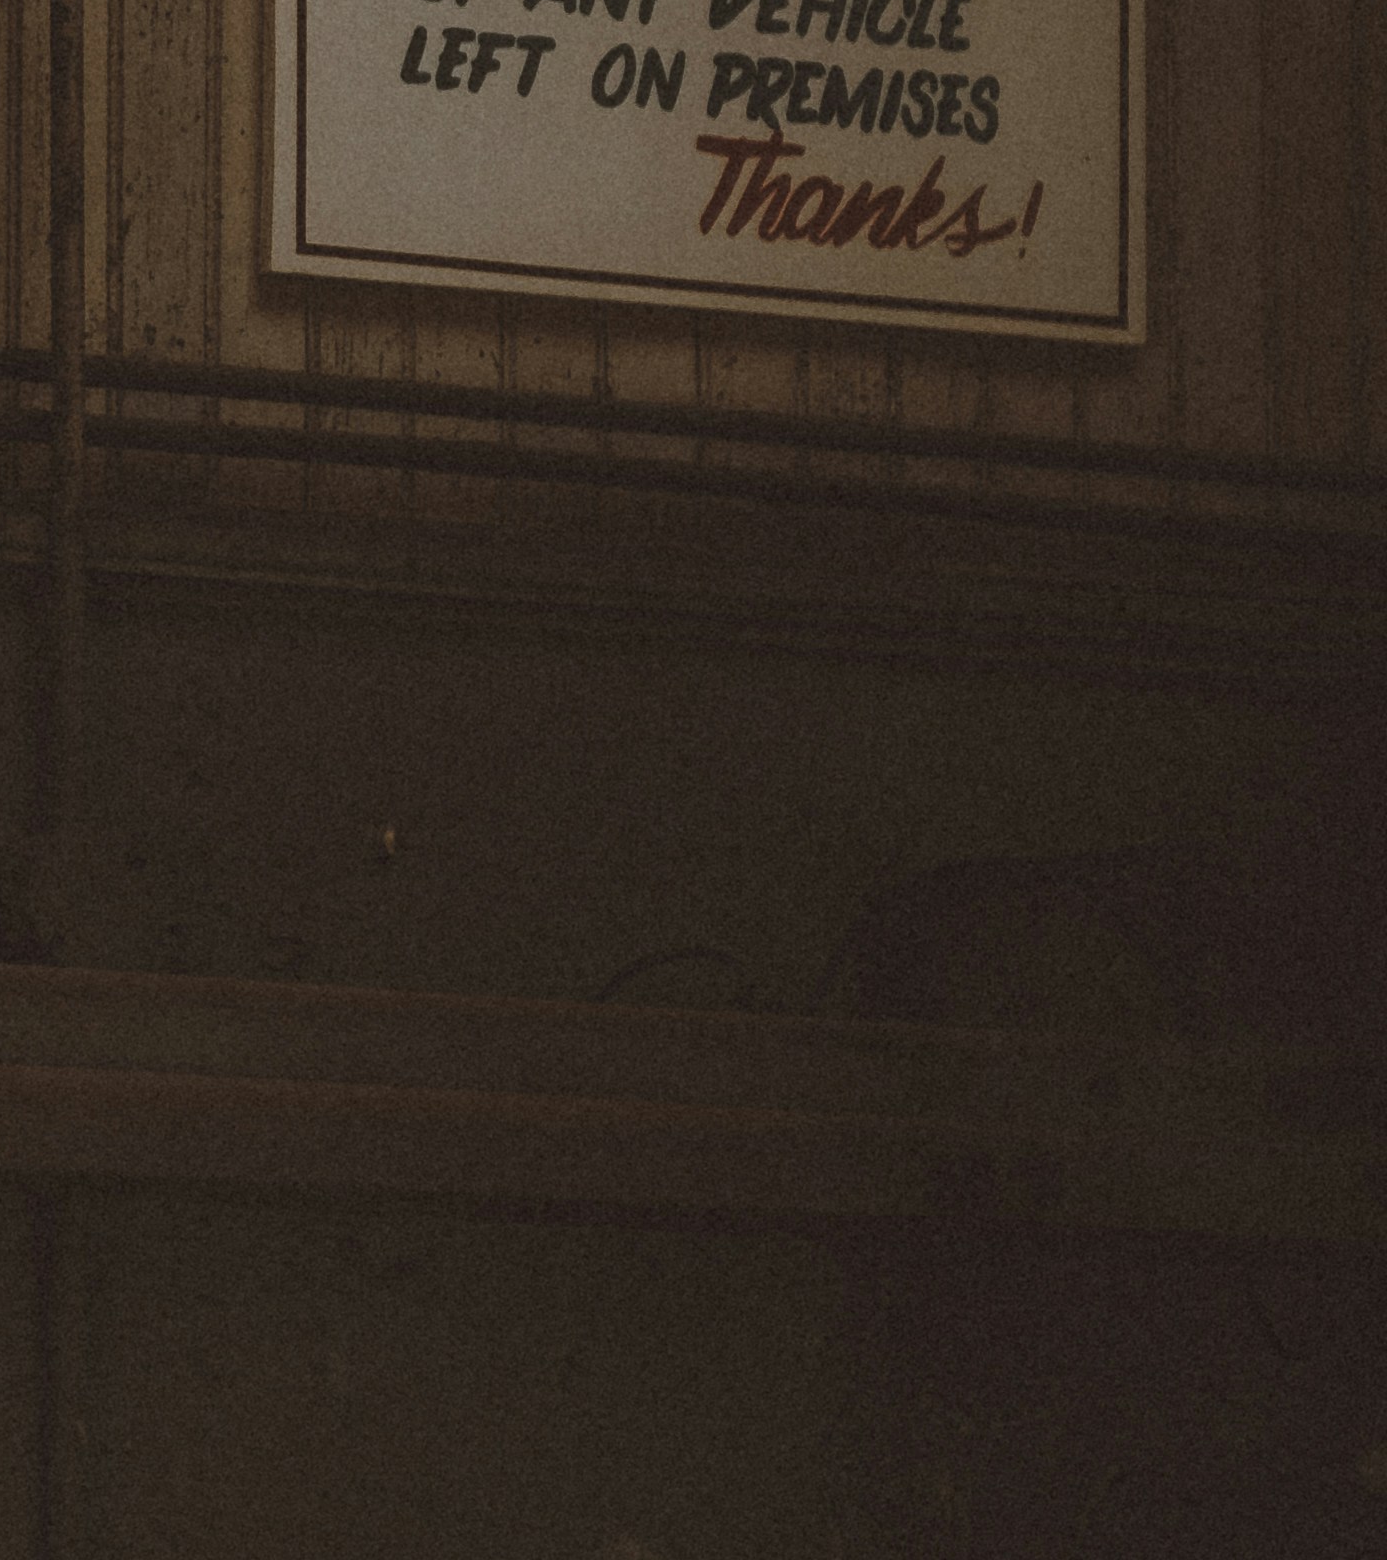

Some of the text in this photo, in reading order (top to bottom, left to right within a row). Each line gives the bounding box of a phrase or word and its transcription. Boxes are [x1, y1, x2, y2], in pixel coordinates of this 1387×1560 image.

[399, 27, 1001, 145] LEFT ON PREMISES
[696, 129, 1042, 259] Thanks!
